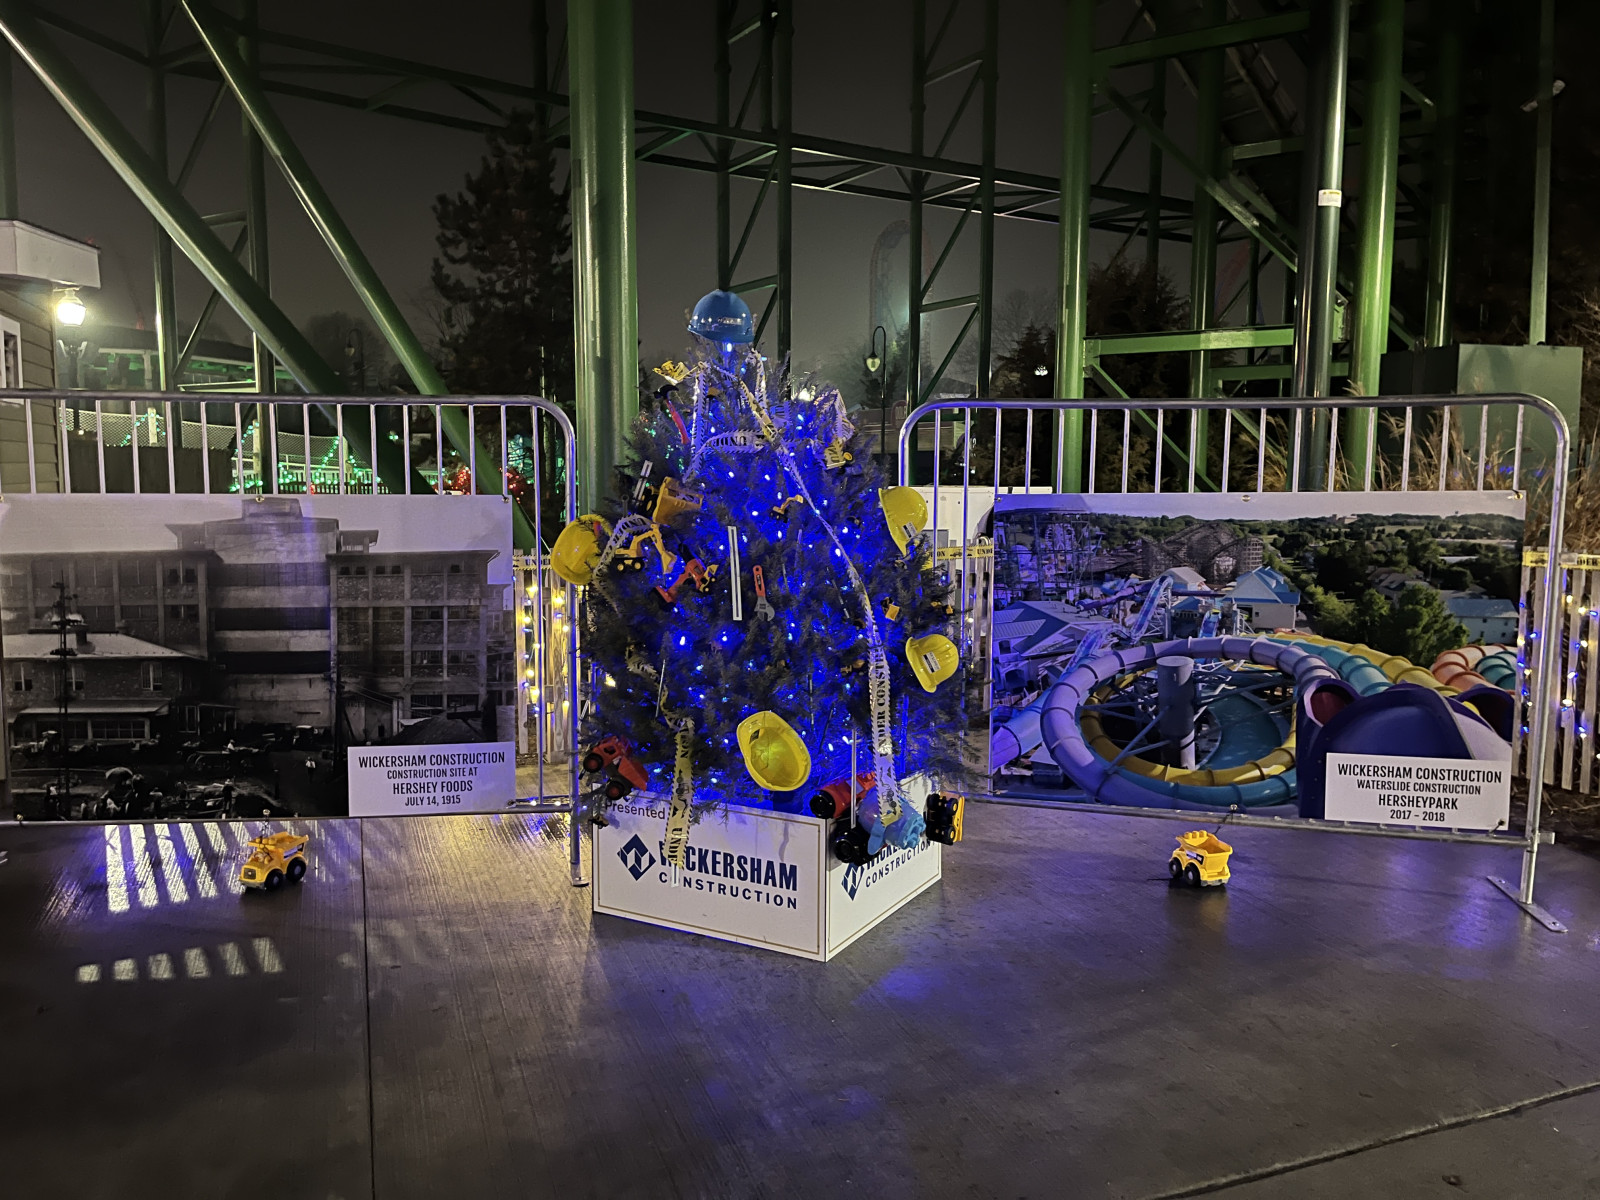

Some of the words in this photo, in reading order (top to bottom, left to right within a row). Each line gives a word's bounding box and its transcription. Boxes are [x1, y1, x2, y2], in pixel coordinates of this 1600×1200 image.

[358, 755, 427, 768] WICKERSHAM
[429, 752, 506, 767] CONSTRUCTION
[387, 768, 448, 780] CONSTRUCTION
[449, 767, 467, 778] SITE
[468, 767, 478, 777] AT
[1337, 763, 1412, 779] WICKERSHAM
[1416, 767, 1502, 784] CONSTRUCTION
[393, 781, 438, 795] HERSHEY
[441, 780, 473, 793] FOODS
[1356, 779, 1411, 792] WATERSLIDE
[1413, 782, 1481, 795] CONSTRUCTION
[405, 796, 425, 806] JULY
[427, 796, 439, 807] 14,
[442, 794, 461, 805] 1915
[1378, 794, 1458, 810] HERSHEYPARK
[605, 801, 666, 820] Presented
[1389, 809, 1412, 820] 2017
[1422, 811, 1445, 822] 2018
[668, 827, 683, 863] UNDE
[658, 840, 798, 891] CKERSHAM
[658, 871, 797, 910] CNSTRUCTION
